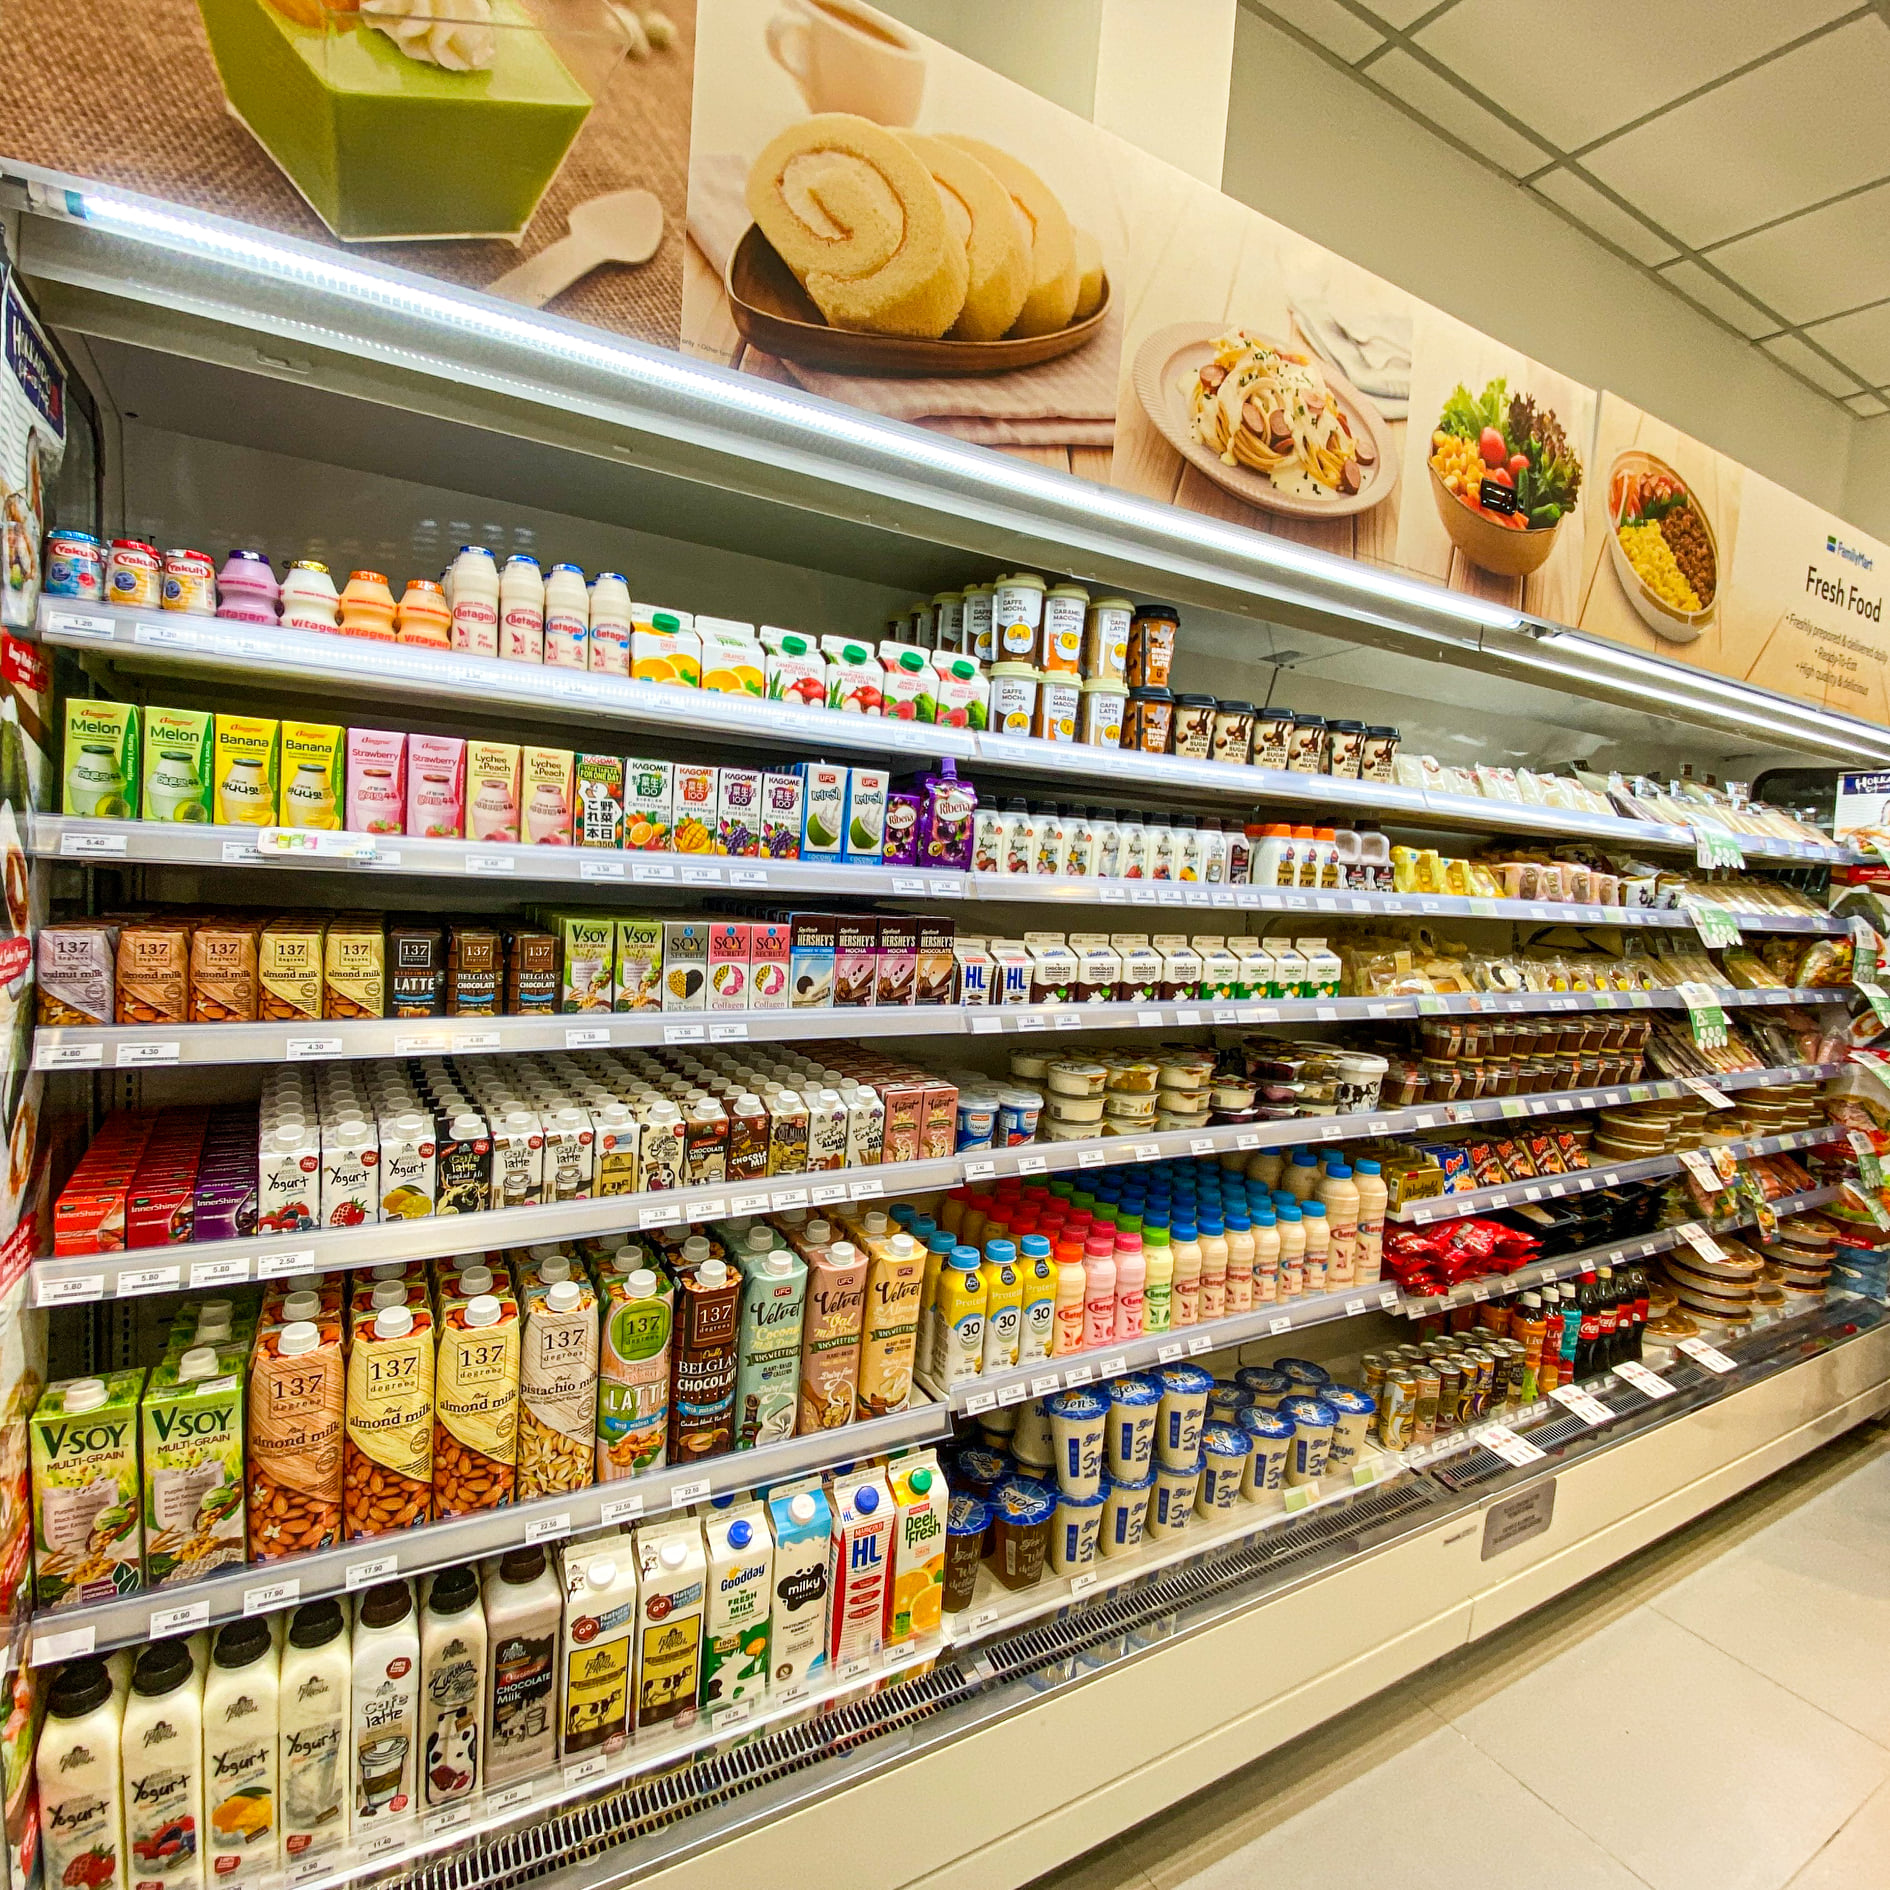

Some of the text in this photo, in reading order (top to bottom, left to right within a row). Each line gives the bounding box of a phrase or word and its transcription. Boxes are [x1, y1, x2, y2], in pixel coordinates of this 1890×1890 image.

[57, 545, 99, 561] Yakult
[1837, 542, 1873, 571] FamilyMart
[169, 563, 206, 576] Yakult
[1806, 566, 1882, 623] Fresh Food
[456, 607, 495, 621] Betagen
[291, 618, 340, 634] Vitagen
[549, 622, 583, 635] Betagen
[1789, 613, 1812, 636] Freshly
[1813, 625, 1841, 646] prepared
[71, 719, 121, 735] Melon
[150, 726, 200, 742] Melon
[220, 733, 269, 748] Banana
[286, 739, 332, 753] Banana
[352, 749, 399, 761] Strawberry
[412, 754, 457, 766] Strawberry
[474, 753, 507, 764] Lychee
[584, 756, 616, 765] KAGOME
[531, 758, 562, 769] Lychee
[632, 763, 668, 772] KAGOME
[580, 770, 619, 782] FOR ONE DAY
[679, 768, 713, 777] KAGOME
[725, 772, 758, 782] KAGOME
[819, 774, 835, 783] UFC
[768, 777, 800, 786] KAGOME
[863, 779, 878, 787] UFC
[641, 786, 657, 795] 100
[687, 791, 704, 800] 100
[732, 796, 747, 805] 100
[775, 800, 791, 808] 100
[938, 801, 970, 815] Ribena
[888, 813, 914, 823] Ribena
[572, 925, 607, 942] V-SOY
[624, 926, 657, 943] V-SOY
[672, 937, 704, 951] SOY
[714, 937, 746, 950] SOY
[756, 937, 786, 950] SOY
[797, 934, 835, 947] HERSHEY'S
[839, 936, 875, 947] HERSHEY'S
[882, 936, 916, 947] HERSHEY'S
[921, 936, 953, 947] HERSHEY'S
[57, 942, 89, 953] 137
[138, 943, 168, 955] 137
[209, 944, 238, 954] 137
[278, 945, 305, 955] 137
[343, 945, 369, 955] 137
[403, 945, 428, 956] 137
[466, 946, 489, 956] 137
[528, 946, 550, 956] 137
[42, 969, 104, 979] walnut milk
[122, 971, 158, 979] almond
[194, 970, 251, 978] almond milk
[299, 970, 318, 978] milk
[328, 970, 359, 978] almond
[457, 973, 495, 981] BELGIAN
[520, 972, 555, 980] BELGIAN
[965, 965, 986, 989] HL
[1006, 967, 1026, 990] HL
[394, 977, 435, 991] LATTE
[457, 981, 495, 989] CHOCOLATE
[519, 981, 555, 989] CHOCOLATE
[712, 1002, 744, 1010] Collagen
[504, 1159, 530, 1168] latte
[557, 1153, 581, 1163] latte
[389, 1159, 428, 1178] Yogurt
[452, 1162, 477, 1172] latte
[268, 1173, 310, 1192] Yogurt
[330, 1167, 370, 1187] Yogurt
[131, 1203, 180, 1212] InnerShine
[197, 1197, 243, 1207] InnerShine
[56, 1210, 106, 1219] InnerShine
[837, 1276, 854, 1285] UFC
[775, 1287, 792, 1297] UFC
[875, 1280, 920, 1304] Velvet
[814, 1291, 861, 1316] Velvet
[699, 1304, 732, 1324] 137
[751, 1302, 800, 1326] Velvet
[1033, 1307, 1050, 1320] 30
[626, 1316, 660, 1336] 137
[999, 1315, 1016, 1328] 30
[962, 1322, 980, 1336] 30
[543, 1329, 585, 1350] 137
[460, 1345, 504, 1367] 137
[543, 1350, 583, 1362] degrees
[370, 1356, 417, 1381] 137
[460, 1367, 502, 1379] degrees
[272, 1374, 323, 1399] 137
[370, 1380, 416, 1393] degrees
[520, 1382, 576, 1396] pistachio
[440, 1389, 516, 1413] almond milk
[609, 1380, 667, 1411] LATTE
[273, 1398, 322, 1412] degrees
[349, 1402, 431, 1428] almond milk
[151, 1407, 234, 1442] V-SOY
[41, 1422, 128, 1459] V-SOY
[253, 1420, 341, 1450] almond milk
[157, 1433, 231, 1454] MULTI-GRAIN
[46, 1451, 125, 1472] MULTI-GRAIN
[615, 1503, 630, 1511] 22.50
[843, 1509, 854, 1522] HL
[540, 1520, 557, 1530] 22.50
[855, 1522, 884, 1538] MARIGOLD
[908, 1519, 941, 1549] Fresh
[851, 1535, 882, 1570] HL
[364, 1564, 383, 1574] 17.90
[721, 1563, 766, 1592] Goodday
[788, 1575, 821, 1596] milky
[728, 1592, 757, 1606] FRESH
[600, 1605, 630, 1622] Natural
[730, 1601, 755, 1615] MILK
[496, 1672, 551, 1695] CHOCOLATE
[497, 1691, 521, 1705] Milk
[366, 1709, 403, 1728] latte
[286, 1729, 342, 1757] Yogurt
[212, 1748, 270, 1778] Yogurt
[131, 1774, 191, 1803] Yogurt
[47, 1800, 110, 1829] Yogurt
[373, 1837, 392, 1848] 11.40
